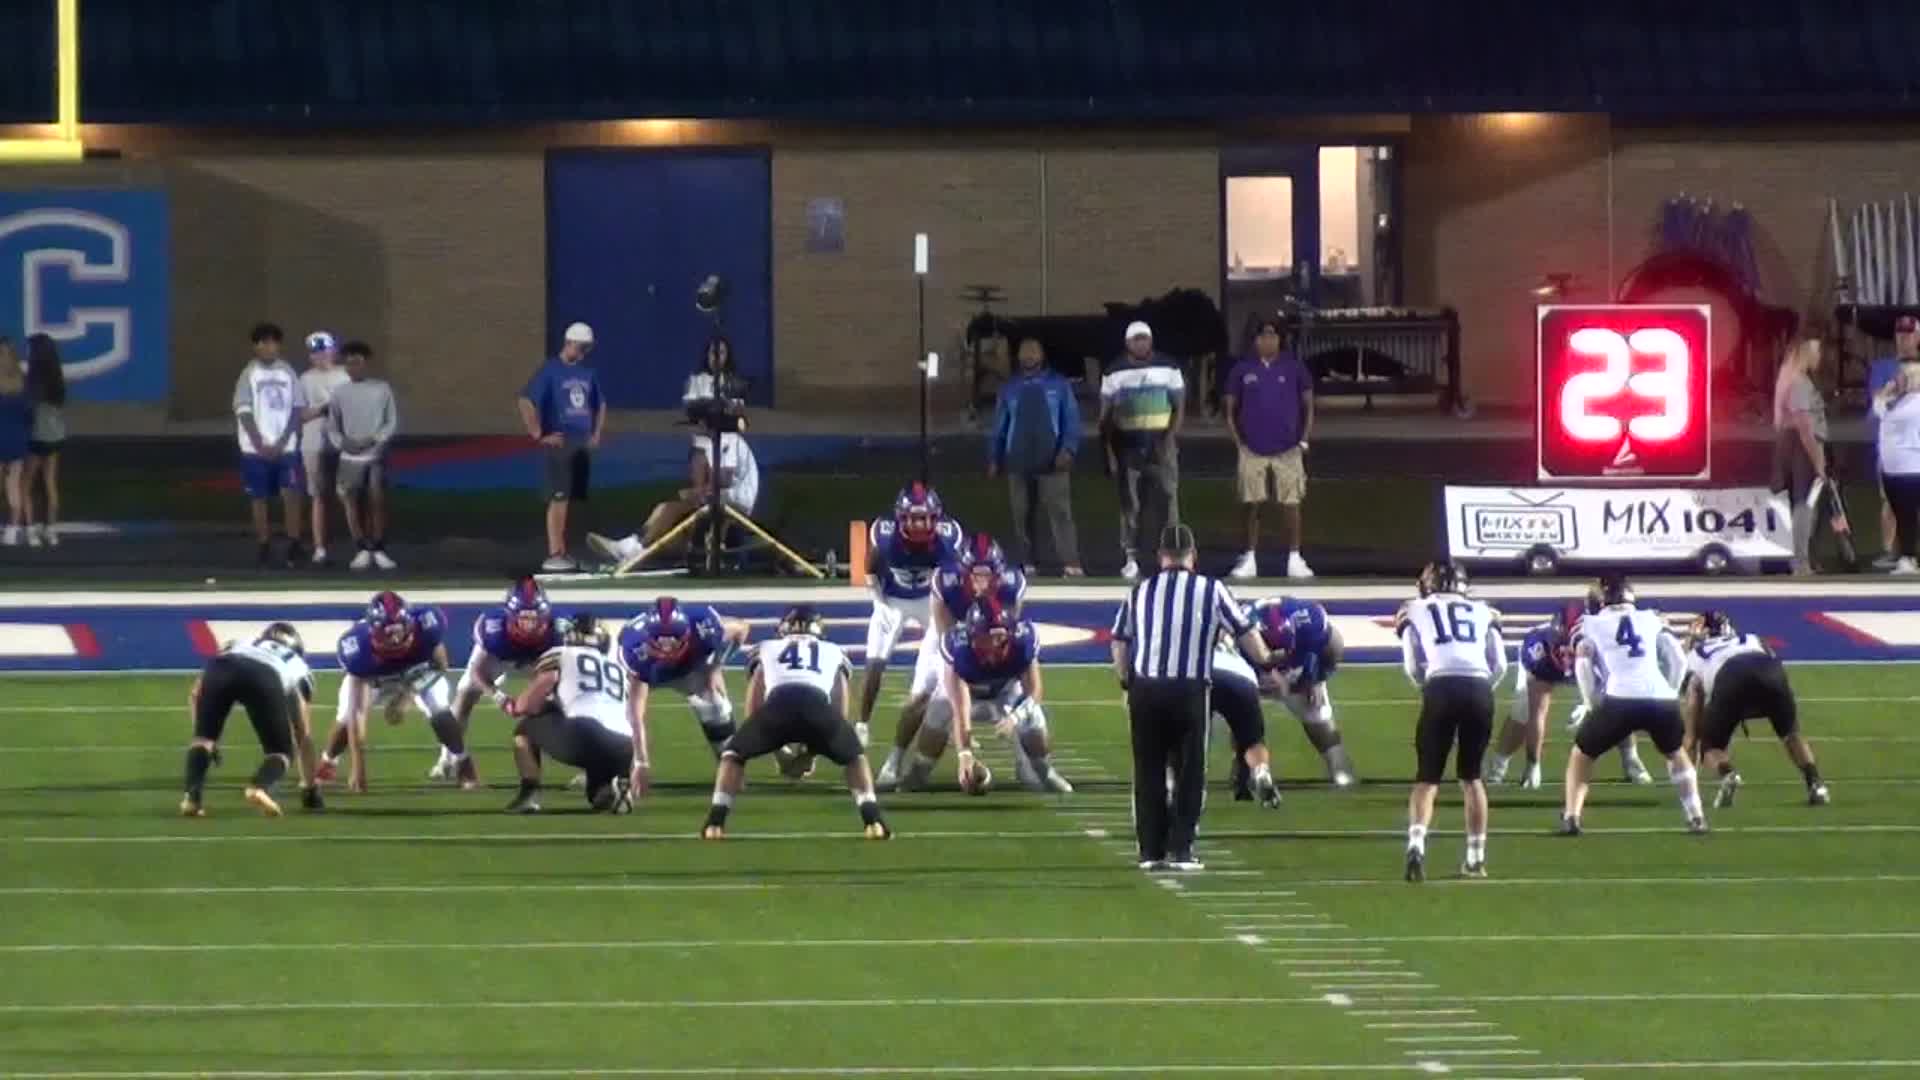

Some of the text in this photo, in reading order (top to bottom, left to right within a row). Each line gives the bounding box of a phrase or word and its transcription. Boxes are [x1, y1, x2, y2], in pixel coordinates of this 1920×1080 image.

[0, 209, 132, 380] C
[1561, 327, 1690, 440] 23
[1603, 497, 1671, 535] MIX
[1427, 602, 1476, 645] 16
[1615, 615, 1645, 658] 4
[577, 654, 624, 702] 99
[778, 641, 822, 673] 41
